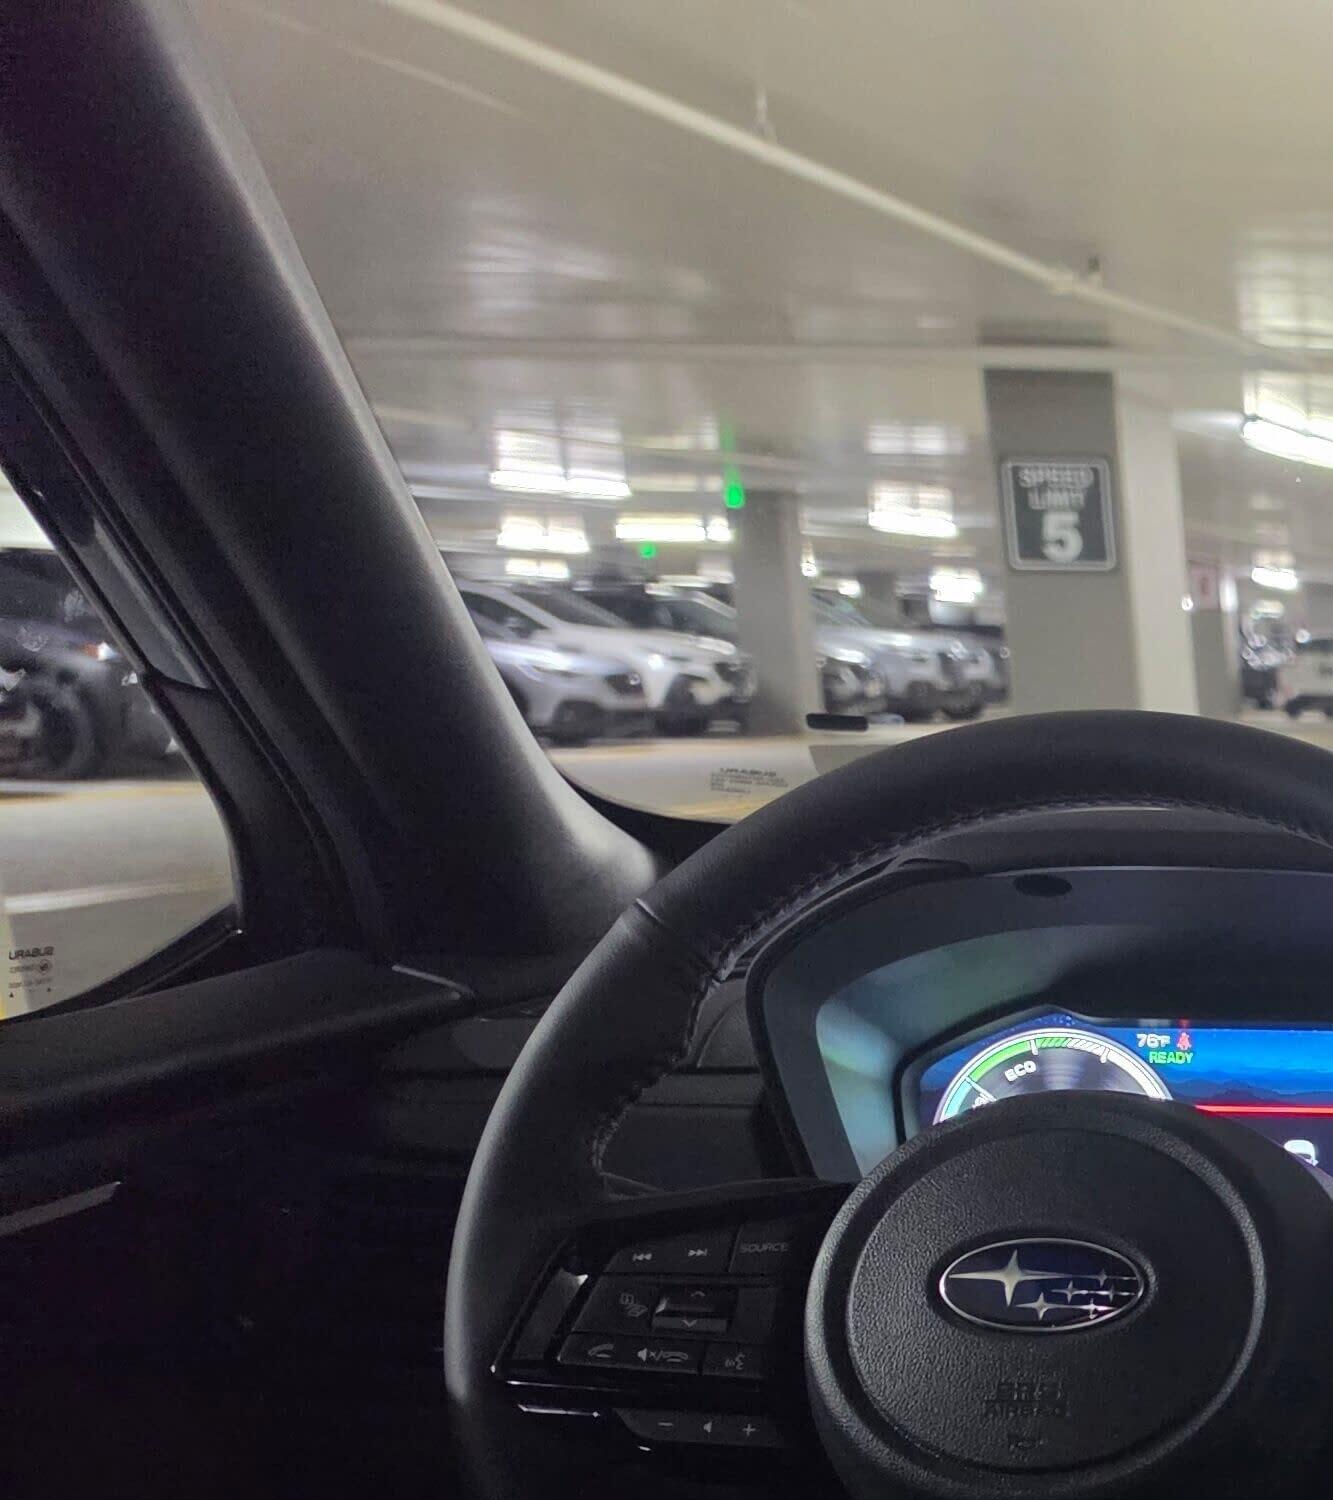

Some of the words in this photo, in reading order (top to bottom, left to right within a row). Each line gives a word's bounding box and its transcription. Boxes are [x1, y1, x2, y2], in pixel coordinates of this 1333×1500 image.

[1019, 467, 1094, 488] SPEED
[1028, 488, 1085, 511] LIMIT
[1041, 511, 1083, 563] 5
[1149, 1052, 1194, 1064] READY
[1004, 1060, 1036, 1082] ECO
